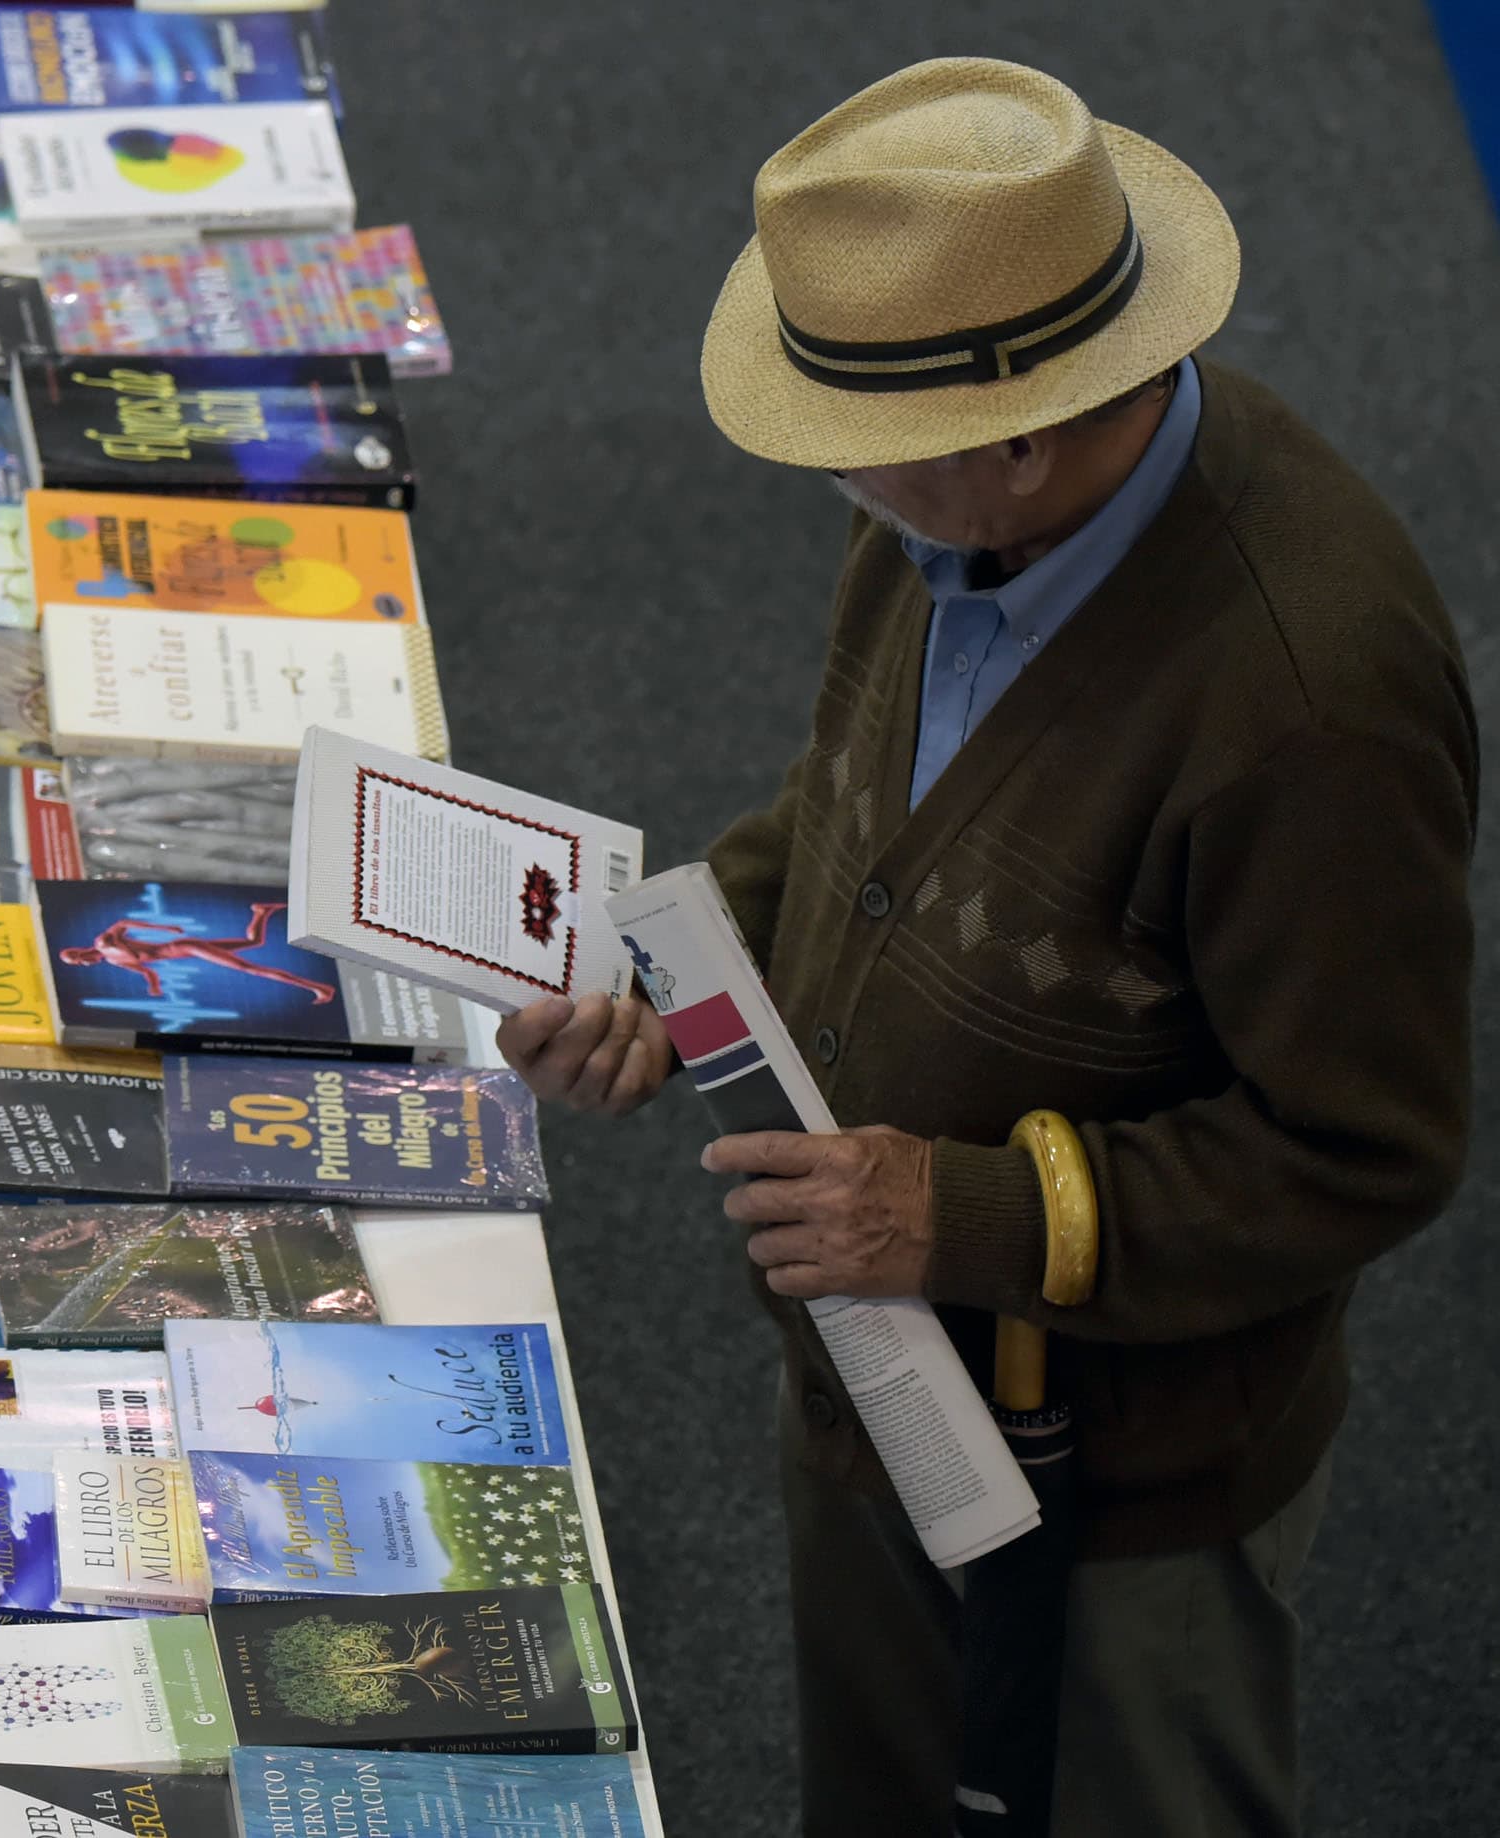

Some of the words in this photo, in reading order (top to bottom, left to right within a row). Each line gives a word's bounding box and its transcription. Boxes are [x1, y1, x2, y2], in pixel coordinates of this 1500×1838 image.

[148, 628, 192, 720] confiar
[372, 790, 383, 836] insultos
[371, 838, 382, 855] los
[370, 858, 381, 871] de
[369, 874, 380, 900] libro
[369, 902, 380, 915] El
[27, 1070, 61, 1083] LOS
[66, 1073, 78, 1085] A
[83, 1072, 140, 1089] JOVEN
[10, 1104, 33, 1126] LOS
[208, 1109, 227, 1131] Los
[228, 1093, 313, 1149] 50
[305, 1071, 350, 1181] Principios
[356, 1112, 392, 1144] del
[22, 1129, 38, 1137] A
[393, 1092, 438, 1169] Milagro
[440, 1121, 459, 1137] de
[7, 1147, 34, 1175] CÓMO
[26, 1140, 55, 1174] JOVEN
[239, 1249, 265, 1288] buscar
[492, 1333, 526, 1418] audiencia
[97, 1389, 116, 1411] TUYO
[101, 1426, 123, 1455] SPACIO
[506, 1422, 531, 1441] tu
[513, 1446, 535, 1457] a
[78, 1471, 113, 1537] LIBRO
[116, 1502, 134, 1525] LOS
[275, 1470, 324, 1560] Aprendiz
[375, 1496, 393, 1519] sobre
[120, 1526, 137, 1544] DE
[133, 1466, 173, 1584] MILAGROS
[306, 1476, 365, 1578] Impecable
[384, 1520, 401, 1562] Reflexiones
[83, 1546, 115, 1569] EL
[281, 1564, 319, 1580] El
[516, 1617, 533, 1645] CAMBIAR
[129, 1646, 157, 1677] Beyer
[235, 1633, 253, 1674] RYDALL
[476, 1602, 529, 1721] EMERGER
[523, 1646, 538, 1661] PARA
[527, 1662, 542, 1682] PASOS
[247, 1682, 262, 1716] DEREK
[531, 1682, 545, 1701] SIETE
[140, 1682, 164, 1734] Christian
[91, 1789, 117, 1811] LA
[603, 1785, 616, 1814] MOSTAZA
[99, 1814, 122, 1826] A
